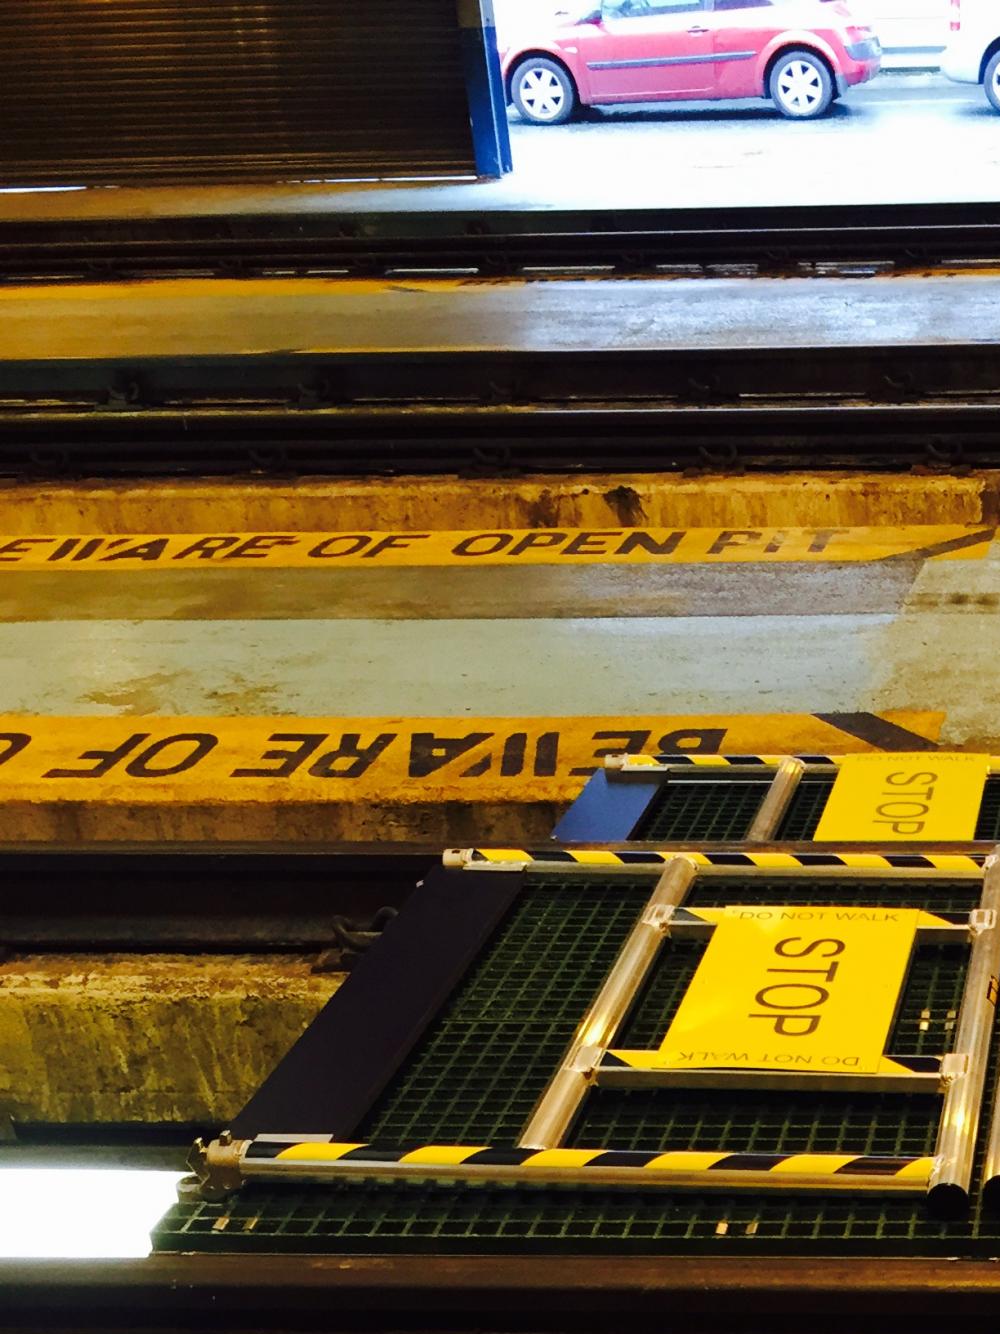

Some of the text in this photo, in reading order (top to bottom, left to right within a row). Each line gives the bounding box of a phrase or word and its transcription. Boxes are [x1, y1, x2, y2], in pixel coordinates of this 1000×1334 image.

[307, 534, 430, 558] OF
[451, 531, 686, 556] OPEN
[707, 530, 850, 555] PIT
[41, 733, 218, 778] OF
[855, 754, 977, 763] DO NOT WALK
[873, 772, 938, 834] STOP
[738, 911, 899, 922] DO NOT WALK
[749, 937, 845, 1036] STOP
[678, 1051, 861, 1067] DO NOT WALK
